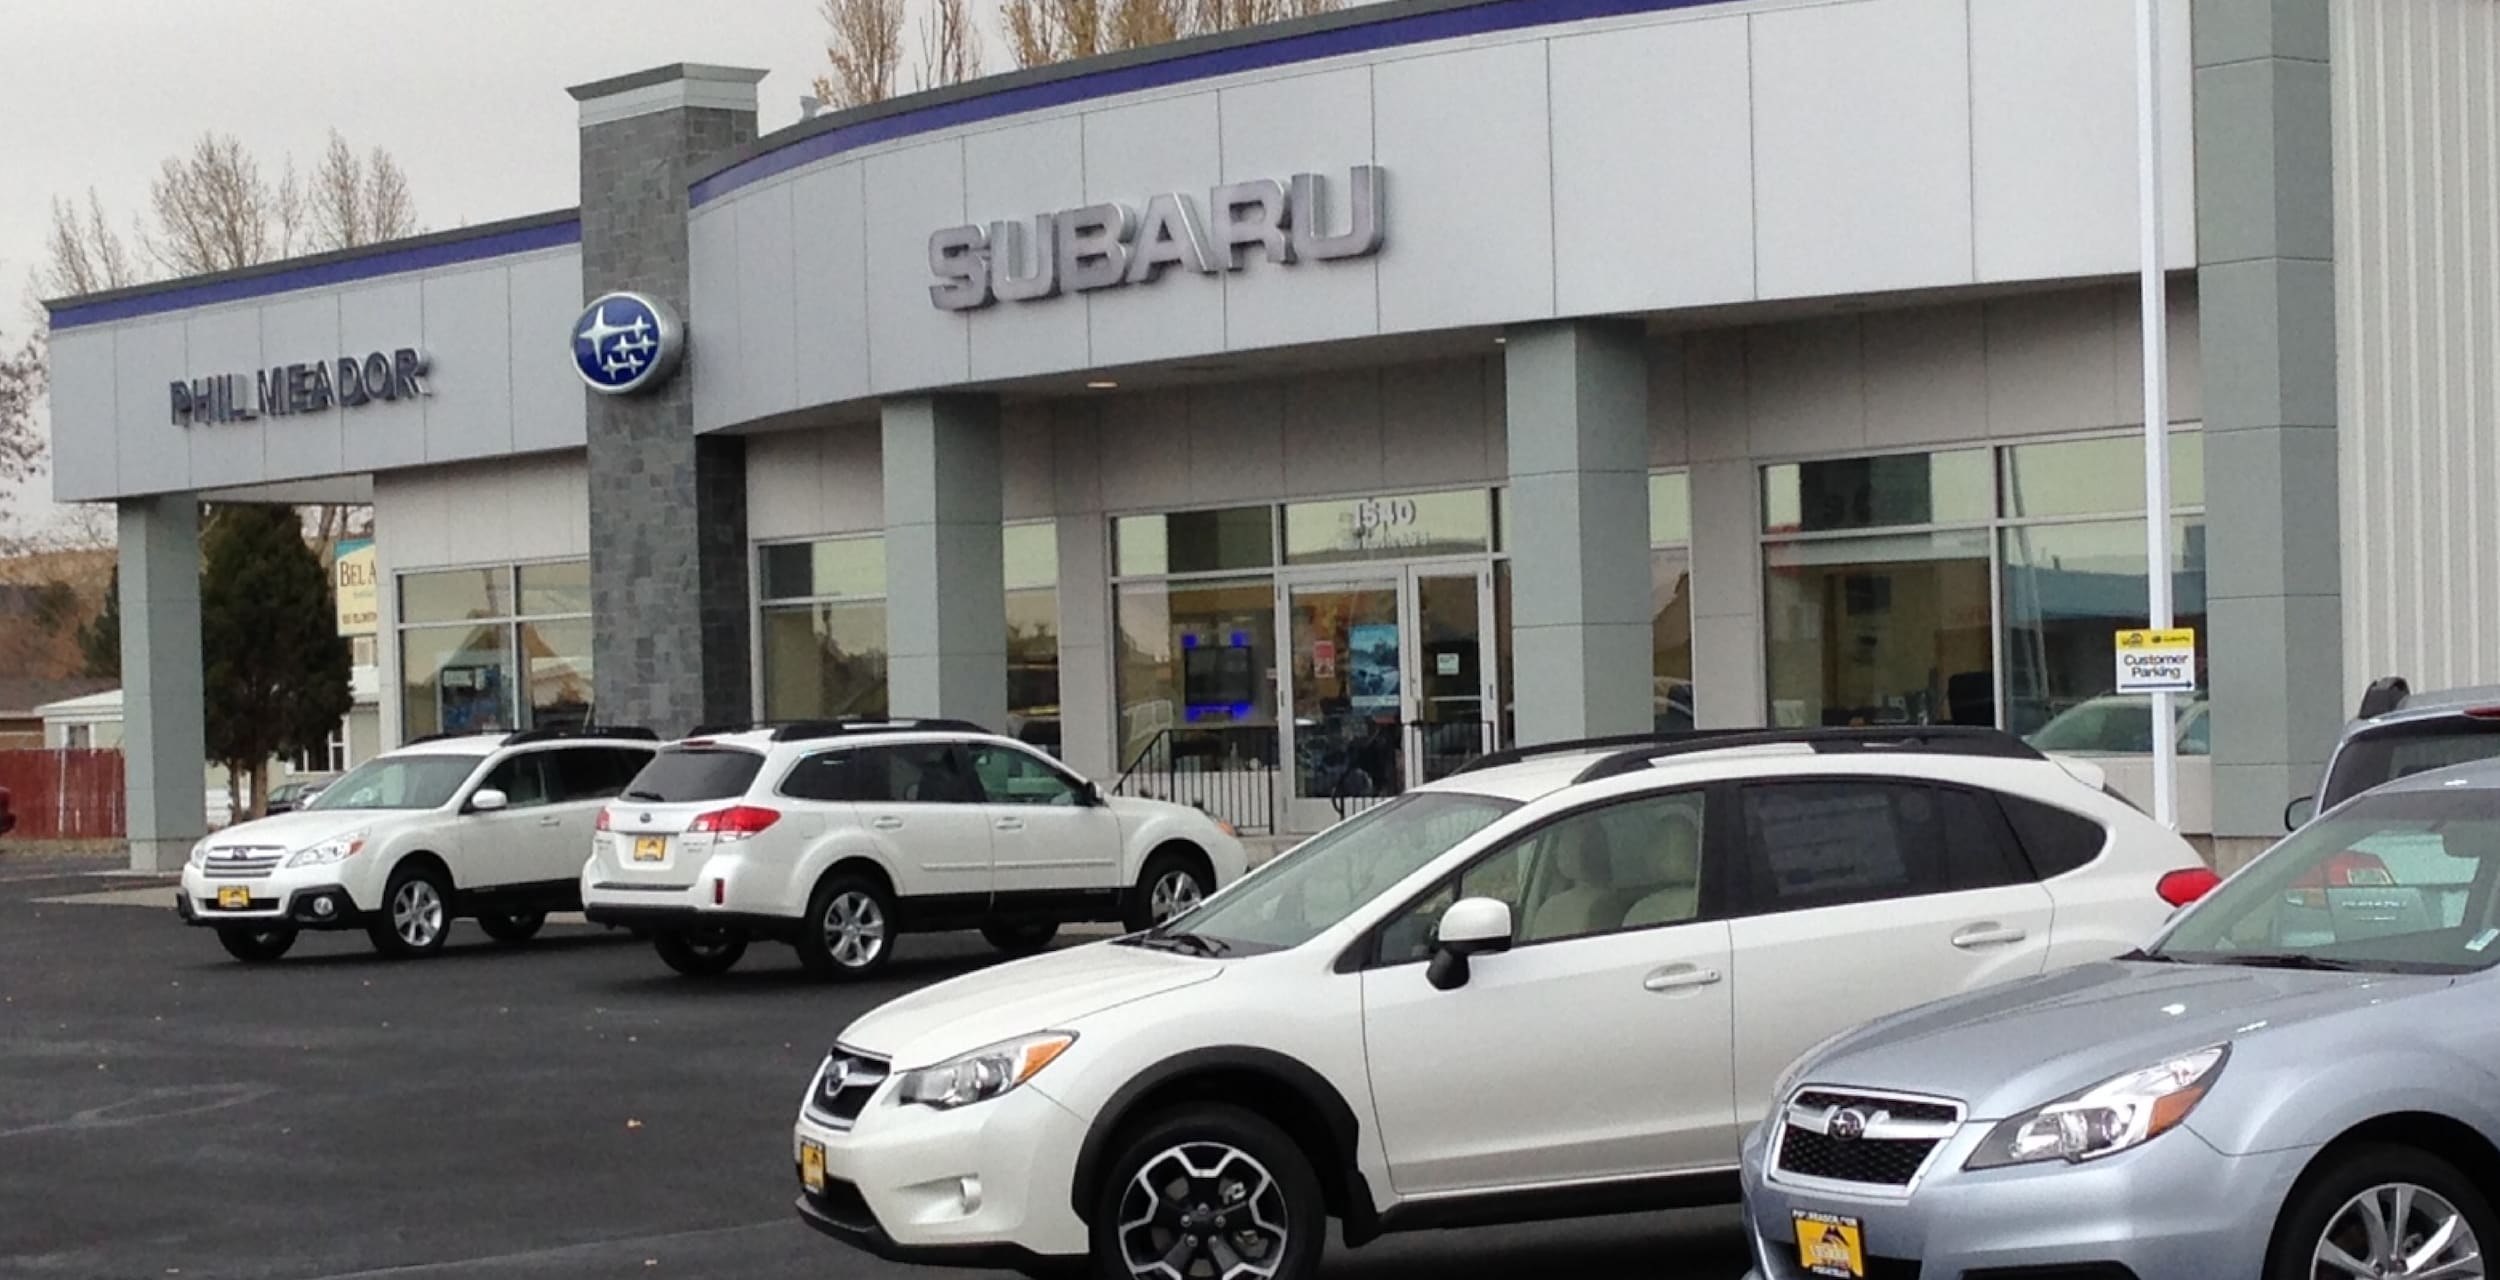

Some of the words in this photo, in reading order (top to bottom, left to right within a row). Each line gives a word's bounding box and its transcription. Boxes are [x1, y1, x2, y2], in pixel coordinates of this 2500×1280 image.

[928, 164, 1386, 312] SUBARU
[170, 374, 256, 426] PHIL
[257, 348, 432, 416] MEADOR
[340, 561, 366, 587] BEL
[2124, 654, 2188, 666] Customer
[2131, 667, 2181, 680] Parking
